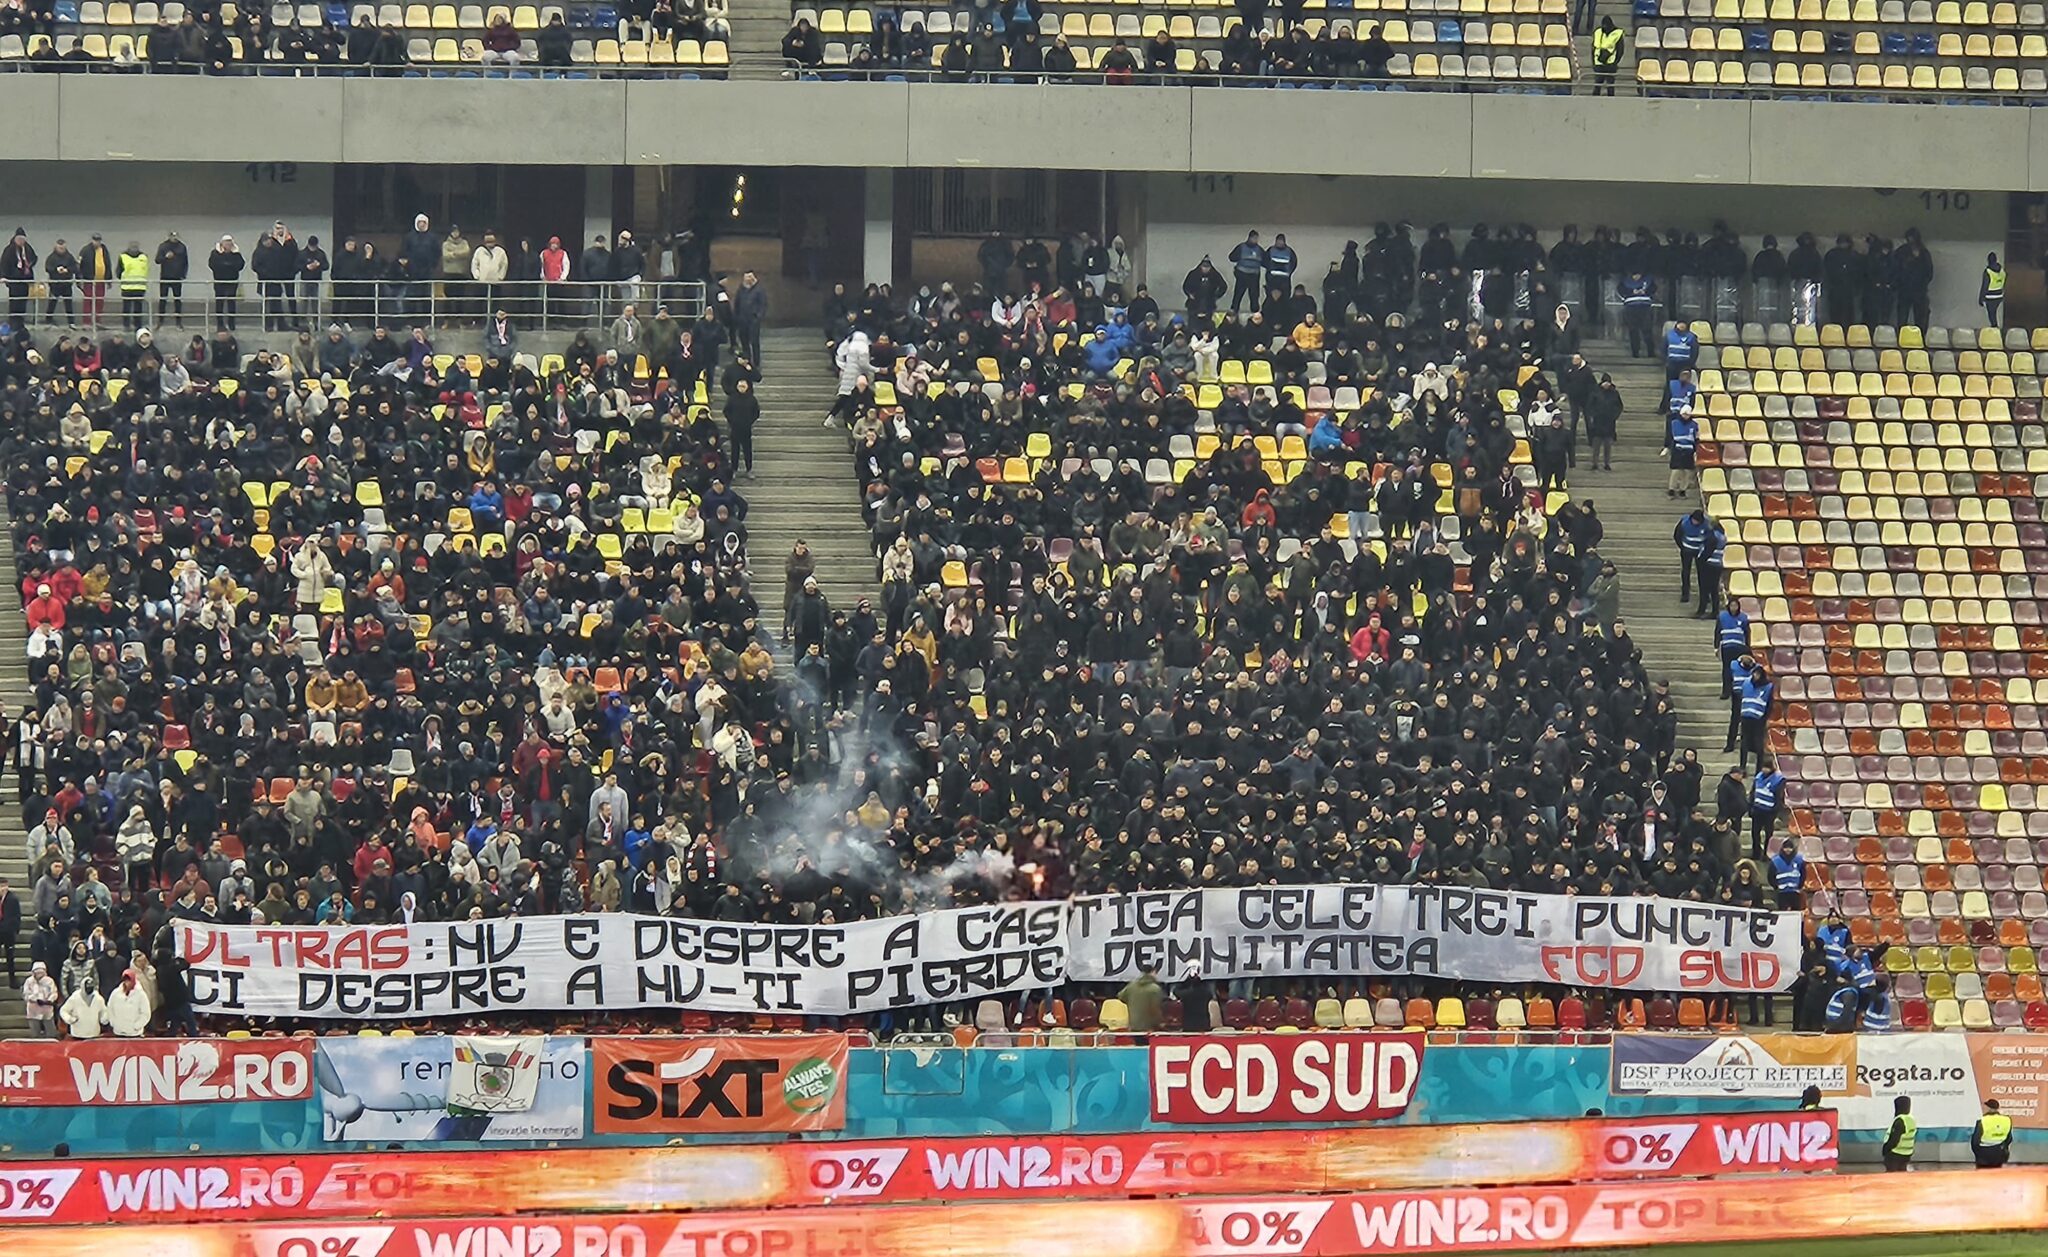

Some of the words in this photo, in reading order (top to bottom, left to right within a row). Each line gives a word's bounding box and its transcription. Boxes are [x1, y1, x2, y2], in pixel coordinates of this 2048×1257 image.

[245, 163, 297, 183] 112
[1184, 173, 1233, 193] 111
[1920, 191, 1970, 211] 110
[563, 919, 600, 961] E
[634, 920, 845, 968] DESPRE
[883, 920, 920, 961] A
[1238, 887, 1377, 931] CELE
[1408, 887, 1538, 939] TREI
[1574, 901, 1778, 949] PUNCTE
[186, 968, 245, 1009] CI
[298, 965, 526, 1014] DESPRE
[566, 964, 604, 1005] A
[849, 945, 1064, 1009] PIERDE
[1103, 934, 1439, 977] DEMNITATEA
[1540, 945, 1645, 988] FCD
[1679, 949, 1782, 989] SUD
[0, 1064, 41, 1088] RT
[69, 1041, 308, 1103] WIN2.RO
[784, 1062, 832, 1093] ALWAYS
[1154, 1043, 1279, 1115] FCD
[1290, 1040, 1419, 1114] SUD
[1622, 1065, 1662, 1079] DSF
[1667, 1066, 1758, 1081] PROJECT
[1856, 1065, 1965, 1087] Regata.ro
[1604, 1133, 1673, 1164] 0%
[810, 1158, 883, 1189] 0%
[926, 1146, 1123, 1190] WIN2.RO
[99, 1167, 304, 1212] WIN2.RO
[1221, 1212, 1302, 1246] 0%
[1351, 1196, 1568, 1248] WIN2.RO
[1602, 1199, 1705, 1229] TOP
